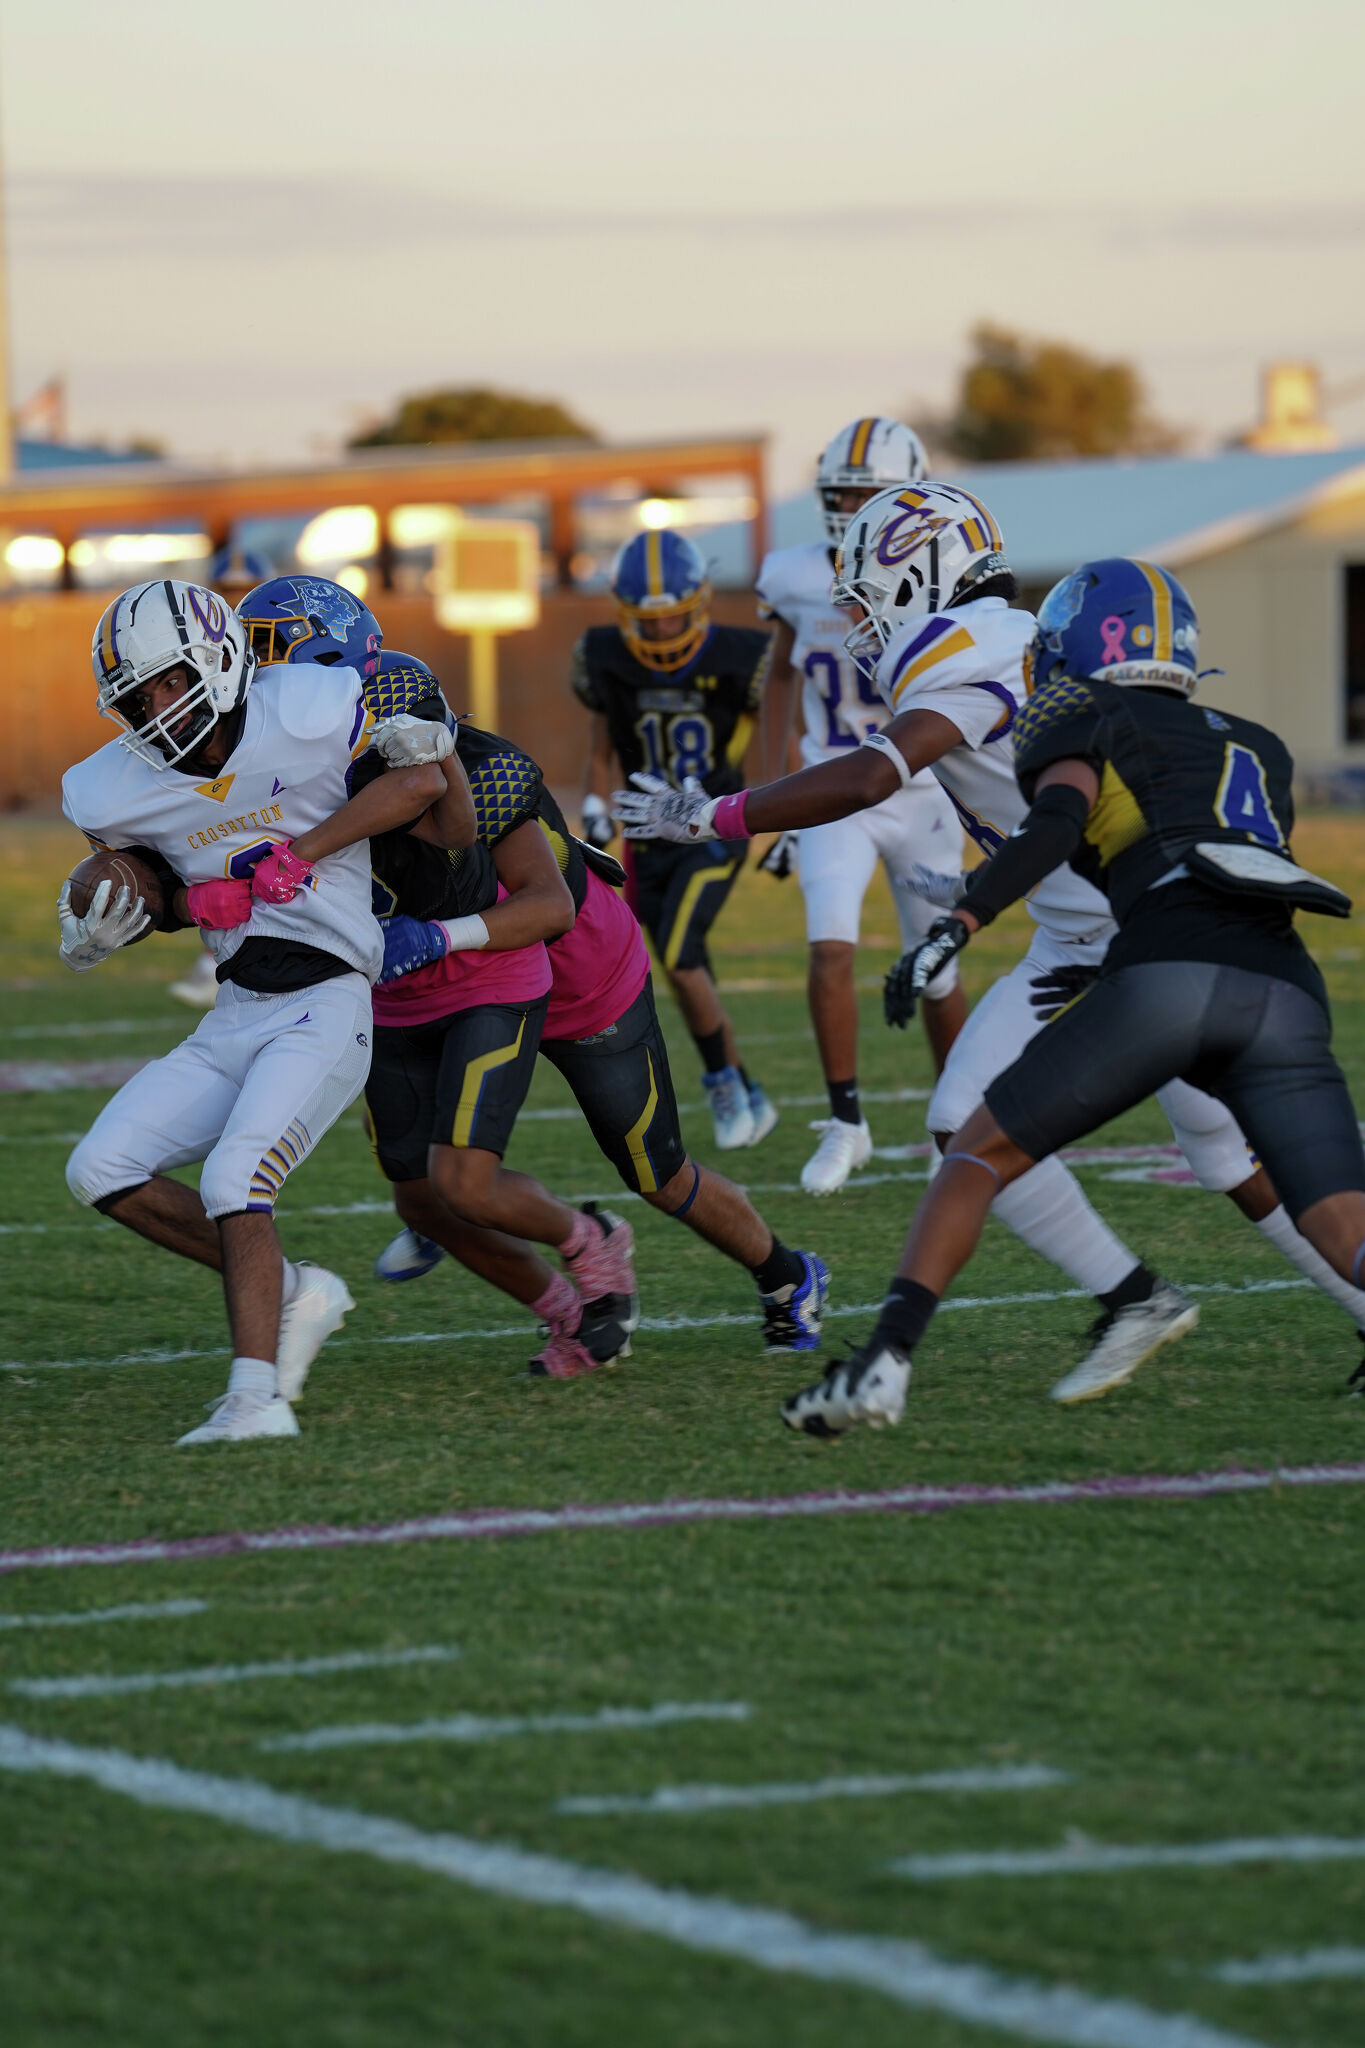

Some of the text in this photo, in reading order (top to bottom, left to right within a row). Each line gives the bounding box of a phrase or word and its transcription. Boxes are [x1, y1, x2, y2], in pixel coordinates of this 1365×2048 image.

[634, 711, 714, 788] 18
[187, 803, 284, 850] CROSBYTON
[1213, 741, 1289, 856] 4
